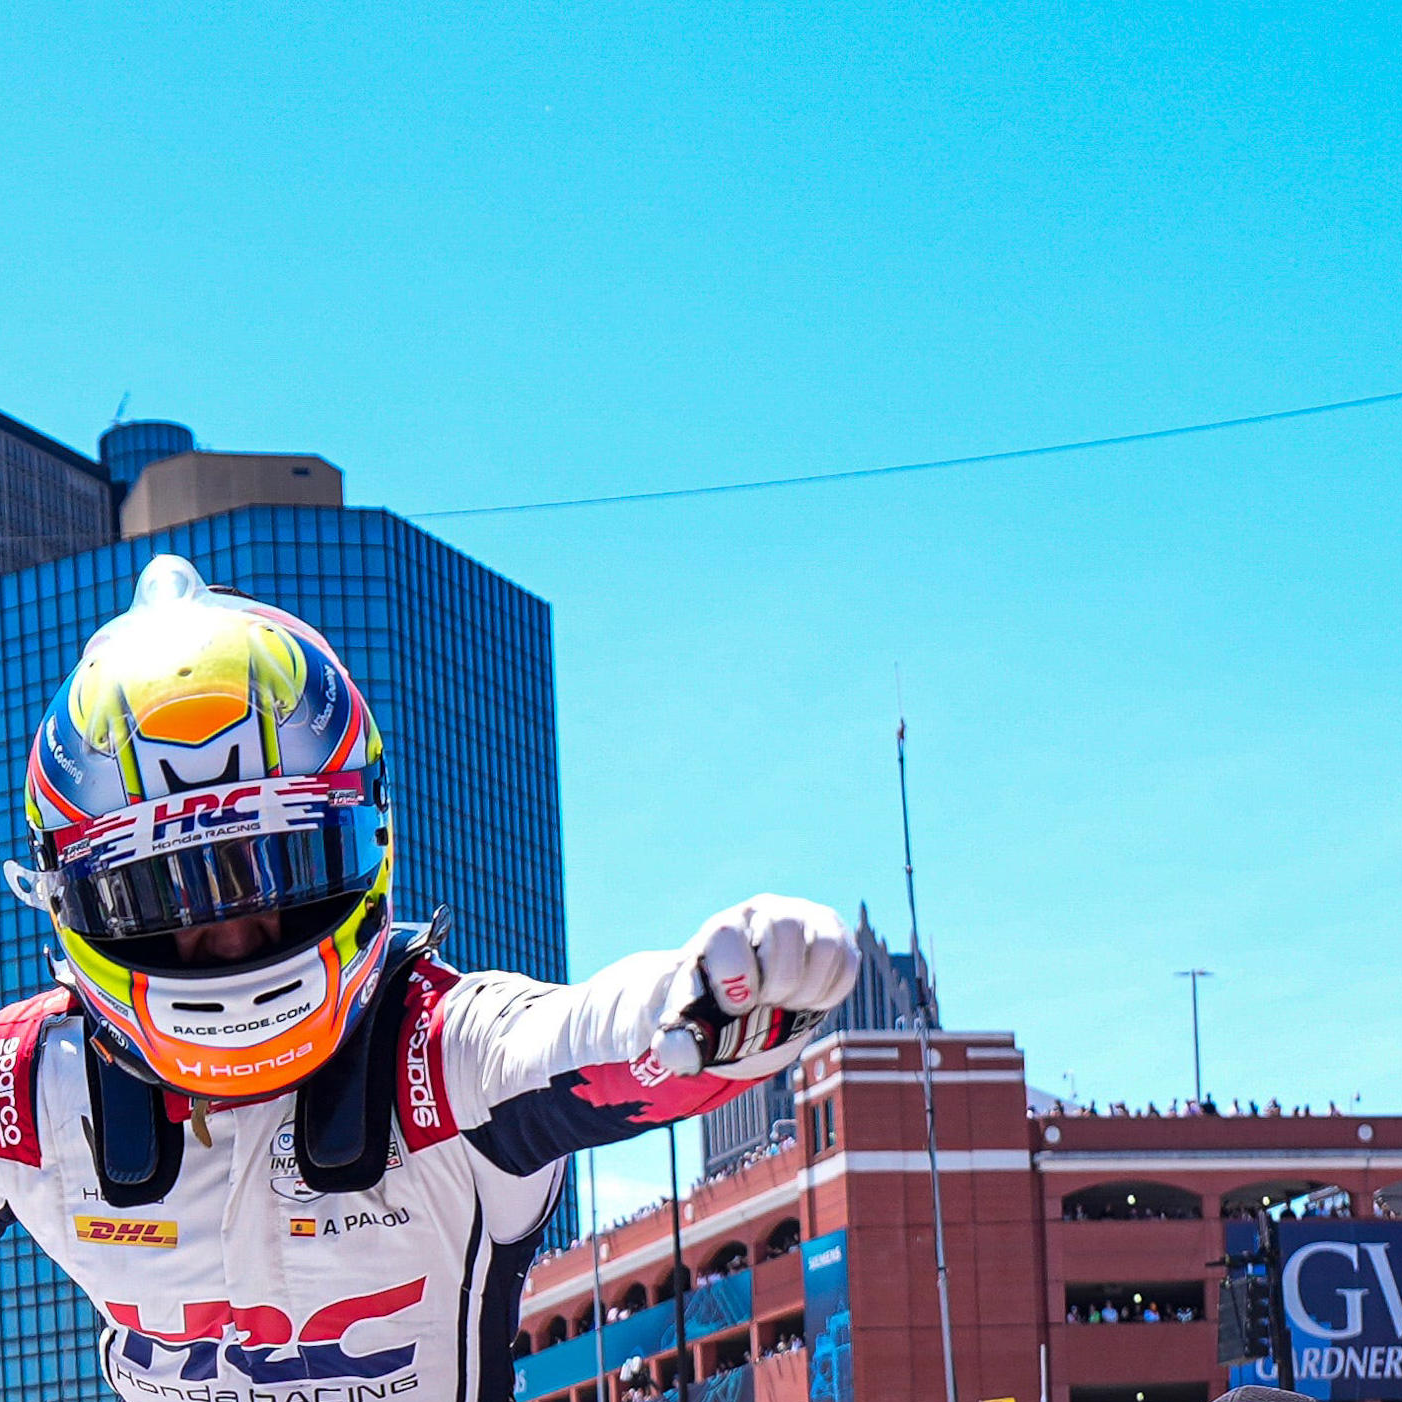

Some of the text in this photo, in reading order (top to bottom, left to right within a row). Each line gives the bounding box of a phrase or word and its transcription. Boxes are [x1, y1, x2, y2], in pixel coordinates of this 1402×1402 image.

[153, 786, 261, 841] HRC
[152, 822, 261, 852] Honda RACING
[173, 1002, 311, 1036] RACE-CODE.COM
[210, 1041, 313, 1077] Honda
[407, 1012, 440, 1128] sparco
[88, 1221, 166, 1244] DHL
[323, 1207, 410, 1235] A. PALOU
[105, 1275, 427, 1385] HRC
